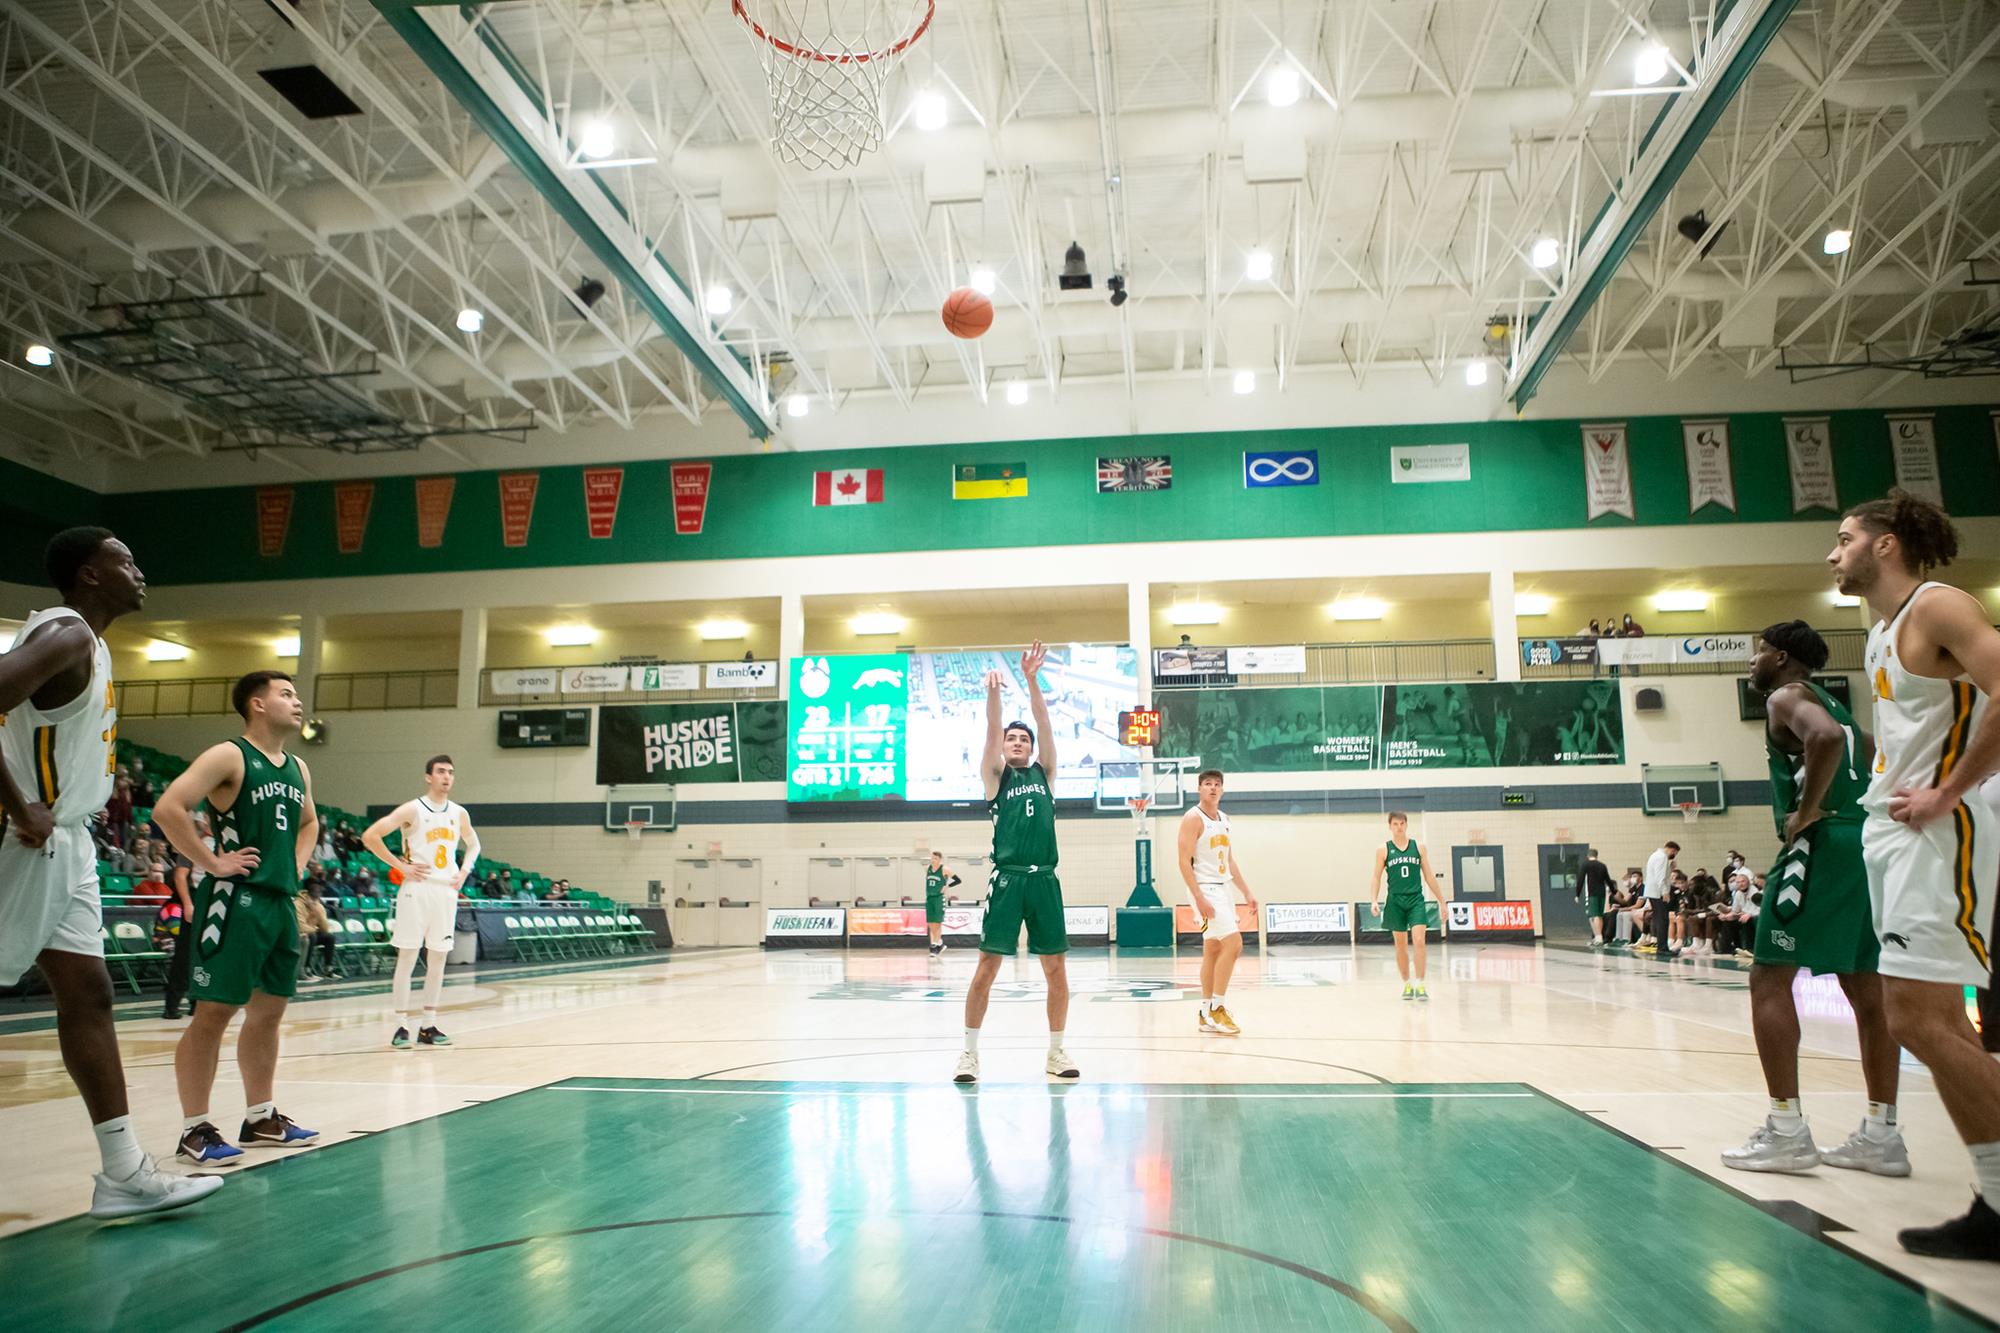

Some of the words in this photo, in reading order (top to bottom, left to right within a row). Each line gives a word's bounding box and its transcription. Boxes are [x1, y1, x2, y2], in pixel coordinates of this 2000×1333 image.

[1114, 483, 1160, 492] TERRITORY
[1704, 638, 1746, 652] Globe
[1130, 713, 1159, 726] 7:04
[643, 715, 731, 747] HUSKIE
[1128, 727, 1151, 744] 24
[1327, 736, 1370, 744] WOMEN'S
[1390, 741, 1418, 749] MEN'S
[645, 737, 733, 773] PRIDE
[1313, 744, 1370, 753] BASKETBALL
[1389, 749, 1446, 757] BASKETBALL
[251, 781, 305, 808] HUSKIES
[1007, 783, 1046, 800] HUSKIES
[1025, 799, 1034, 817] 6
[275, 803, 287, 831] 5
[434, 844, 447, 869] 8
[1388, 856, 1420, 867] HUSKIES
[1401, 866, 1409, 878] 0
[1276, 908, 1336, 919] STAYBRIDGE
[1476, 905, 1530, 927] USPORTS.CA
[773, 917, 834, 930] HUSKIEFAN
